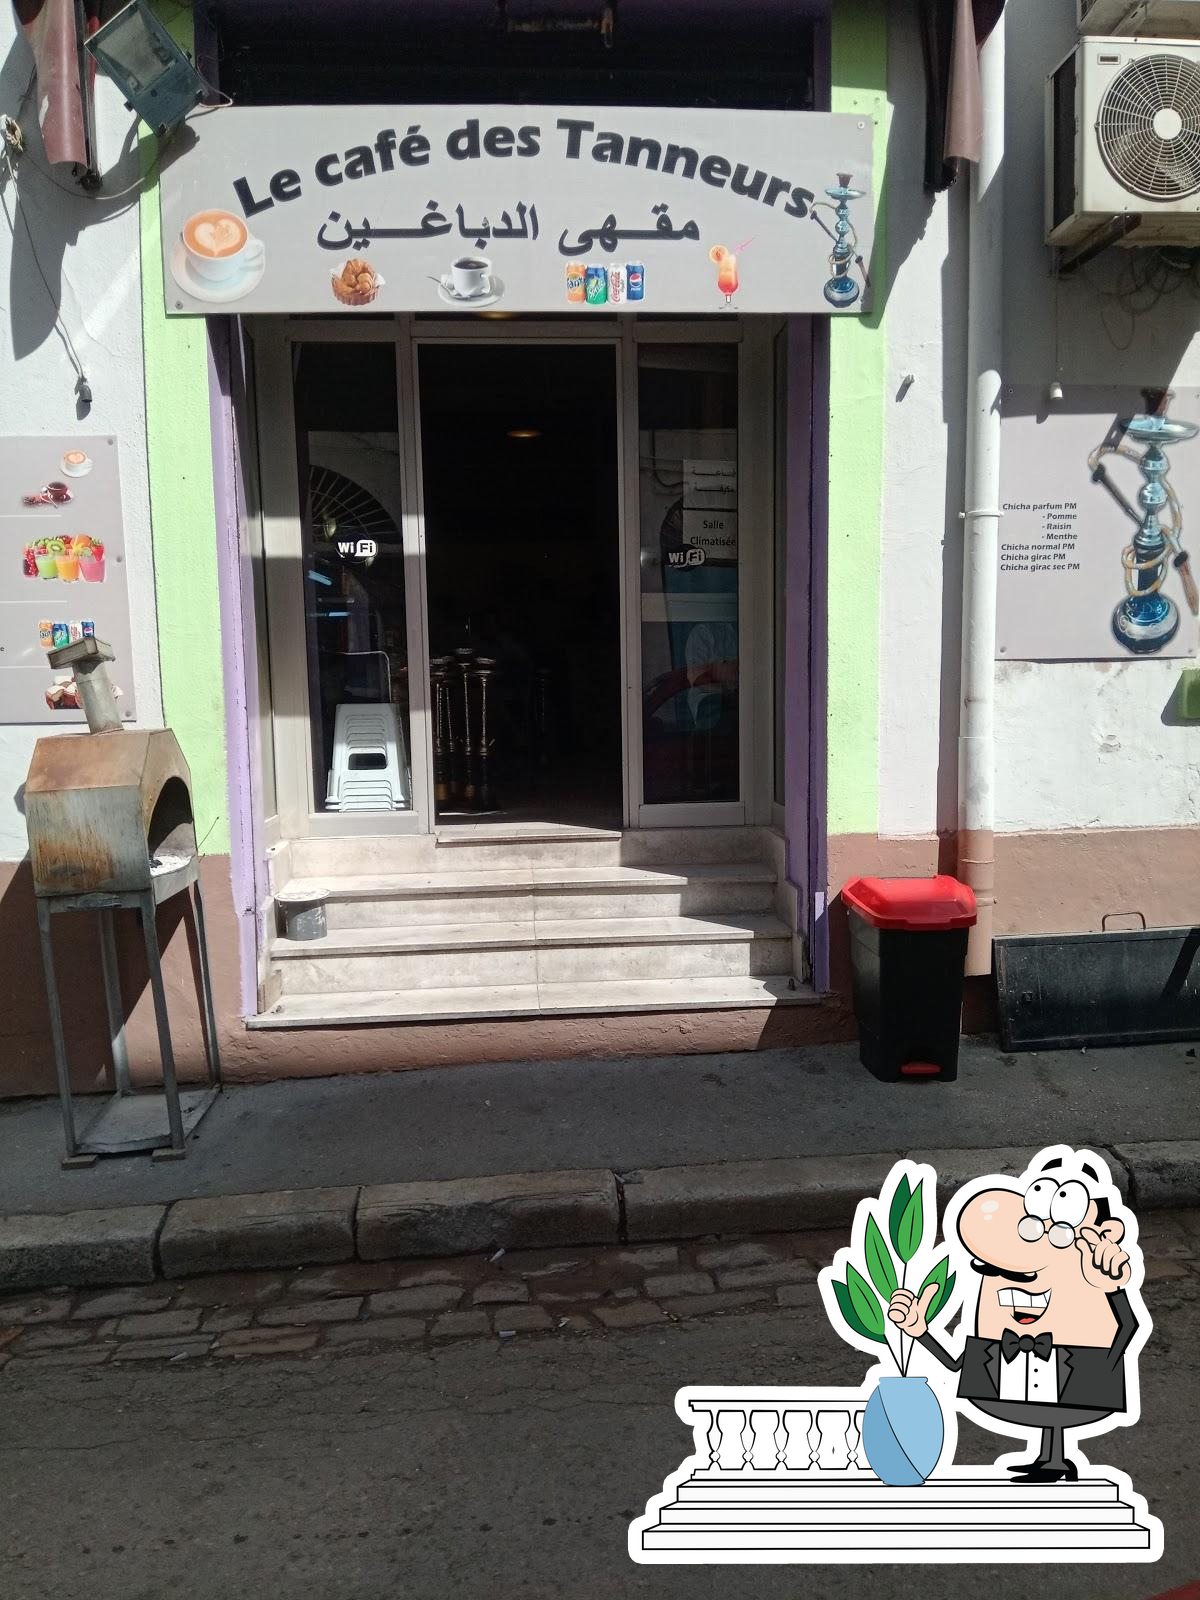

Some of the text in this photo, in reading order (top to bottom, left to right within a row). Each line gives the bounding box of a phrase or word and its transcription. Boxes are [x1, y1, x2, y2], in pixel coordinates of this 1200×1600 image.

[232, 118, 815, 219] Le café des Tanneurs
[317, 199, 700, 256] مقهى الدباغين
[1032, 503, 1063, 511] parfum
[1064, 502, 1077, 510] PM
[703, 520, 724, 529] Salle
[1030, 554, 1052, 562] girac
[1030, 564, 1051, 572] girac
